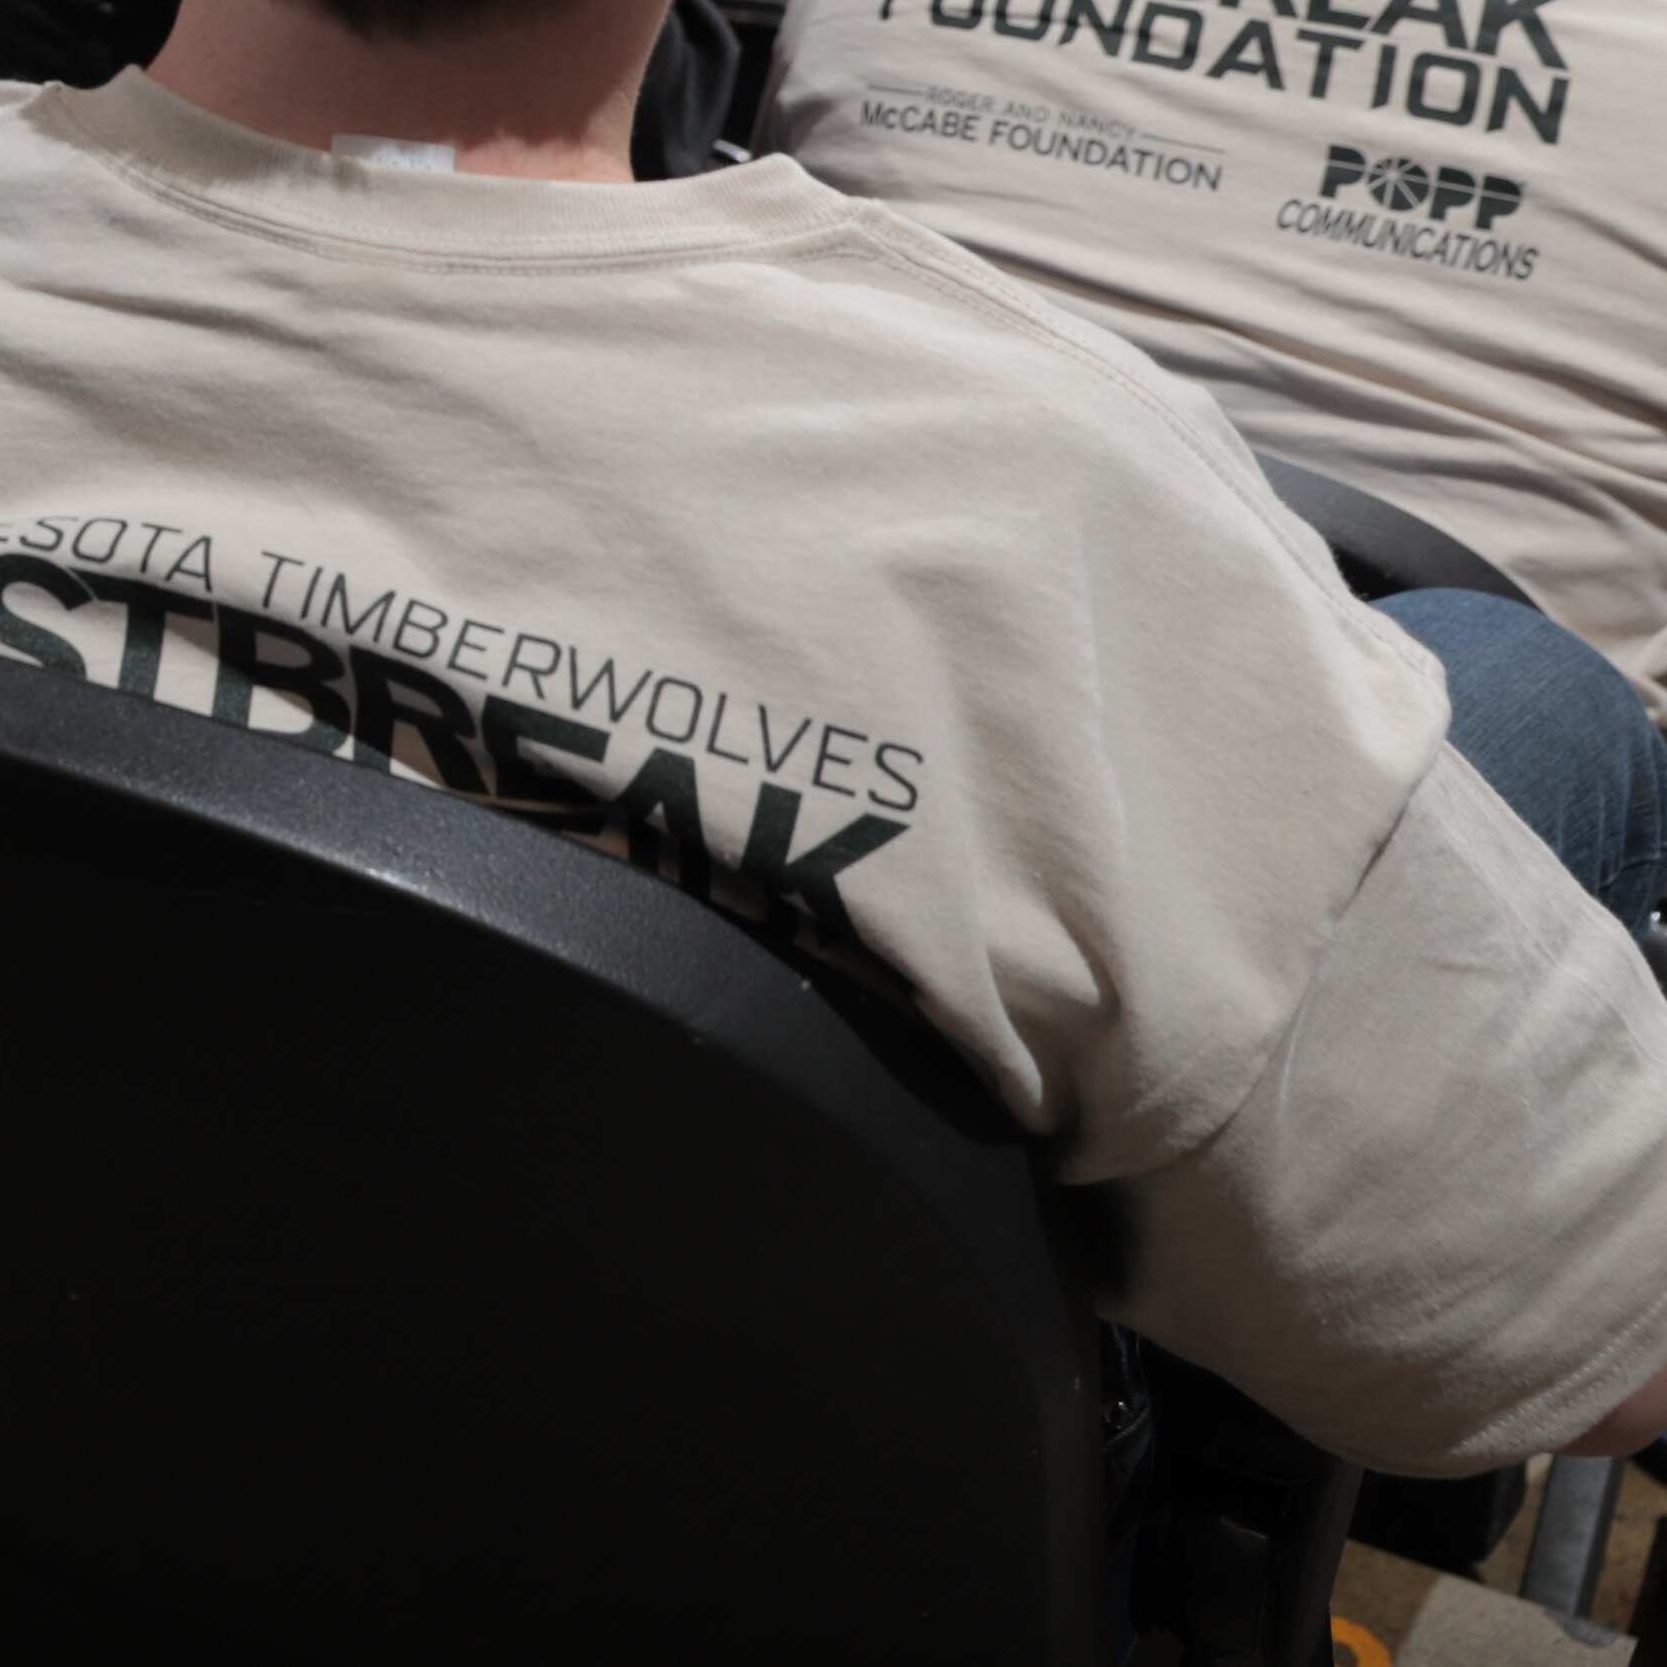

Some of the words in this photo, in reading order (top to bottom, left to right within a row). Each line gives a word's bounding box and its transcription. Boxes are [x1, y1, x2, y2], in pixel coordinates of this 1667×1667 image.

[858, 100, 982, 142] McCABE
[987, 119, 1224, 192] FOUNDATION
[923, 85, 995, 112] ROGER
[1001, 100, 1051, 124] AND
[1058, 110, 1137, 142] NANCY
[1319, 144, 1524, 231] POPP
[1275, 199, 1541, 281] COMMUNICATIONS
[261, 549, 925, 813] TIMBERWOLVES
